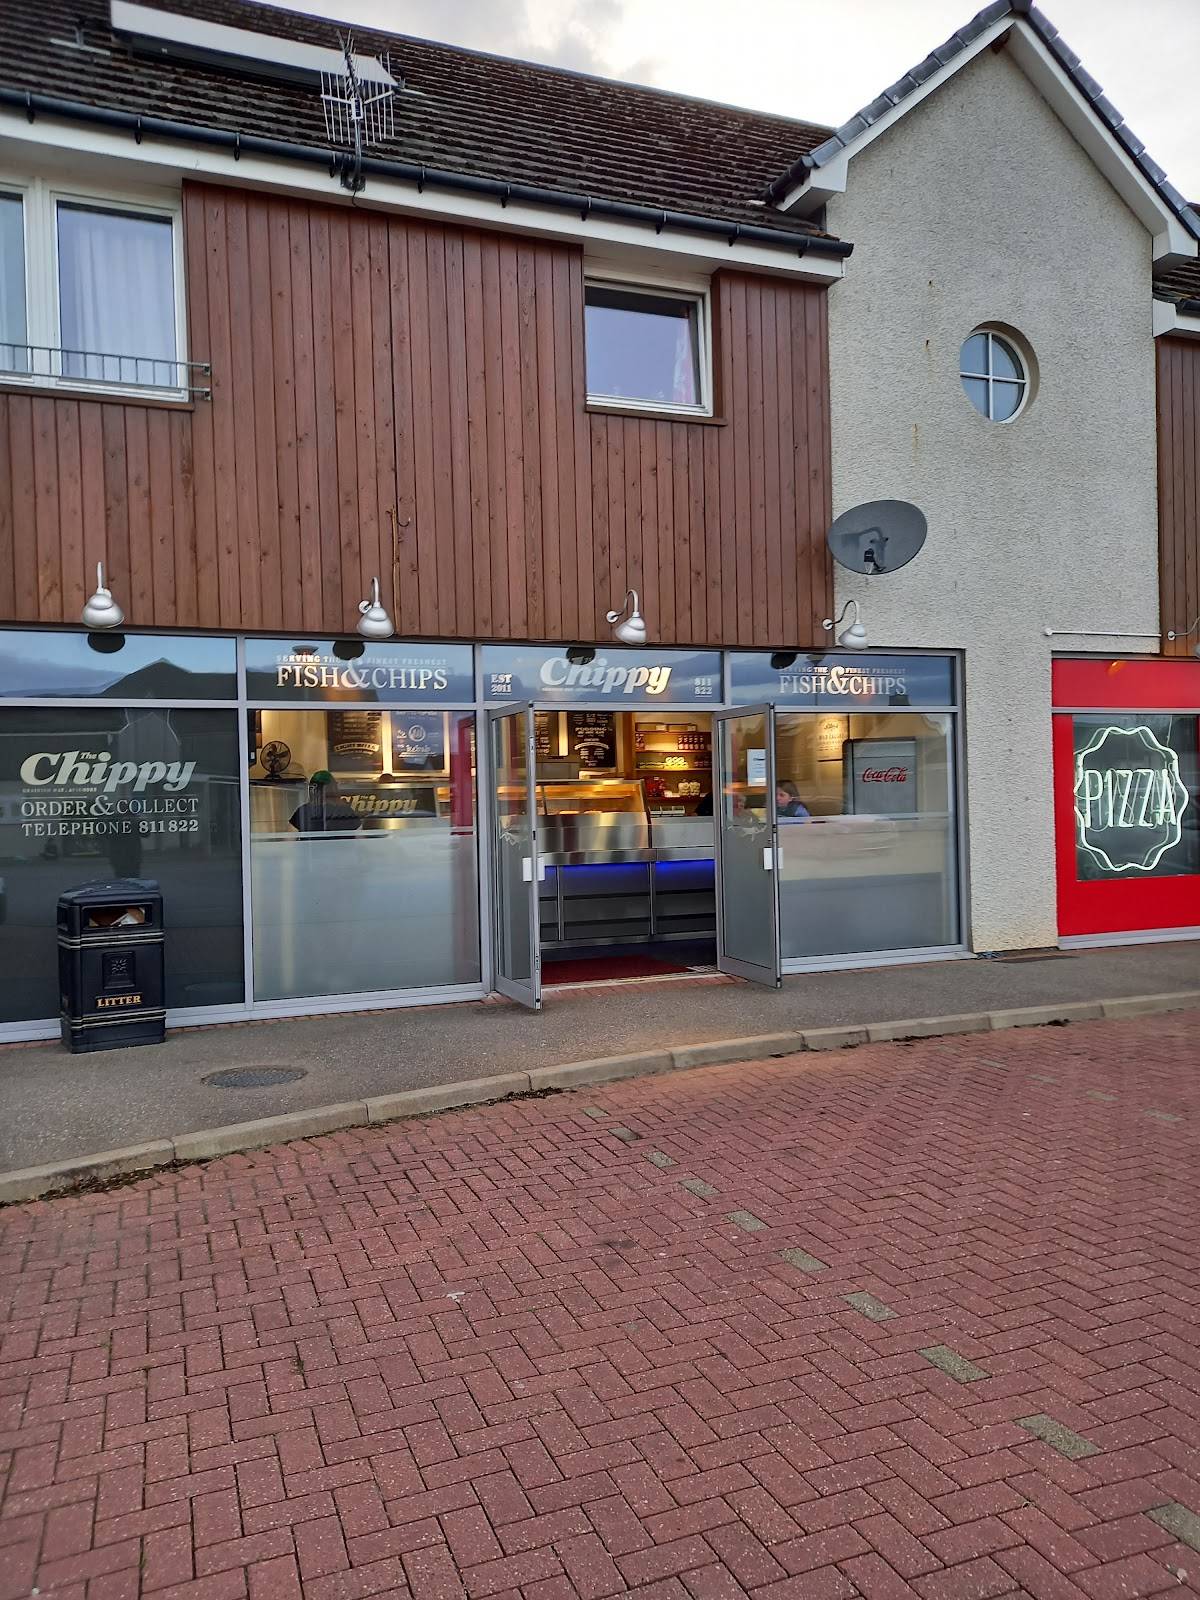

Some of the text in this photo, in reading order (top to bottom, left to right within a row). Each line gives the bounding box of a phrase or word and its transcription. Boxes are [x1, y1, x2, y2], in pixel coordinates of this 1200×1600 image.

[491, 674, 512, 683] EST
[491, 684, 512, 692] 2011
[694, 686, 712, 695] 822
[80, 751, 98, 760] The
[20, 750, 197, 793] Chippy
[1084, 768, 1177, 828] PIZZA
[21, 819, 199, 837] TELEPHONE 811 822
[97, 995, 141, 1007] LITTER
